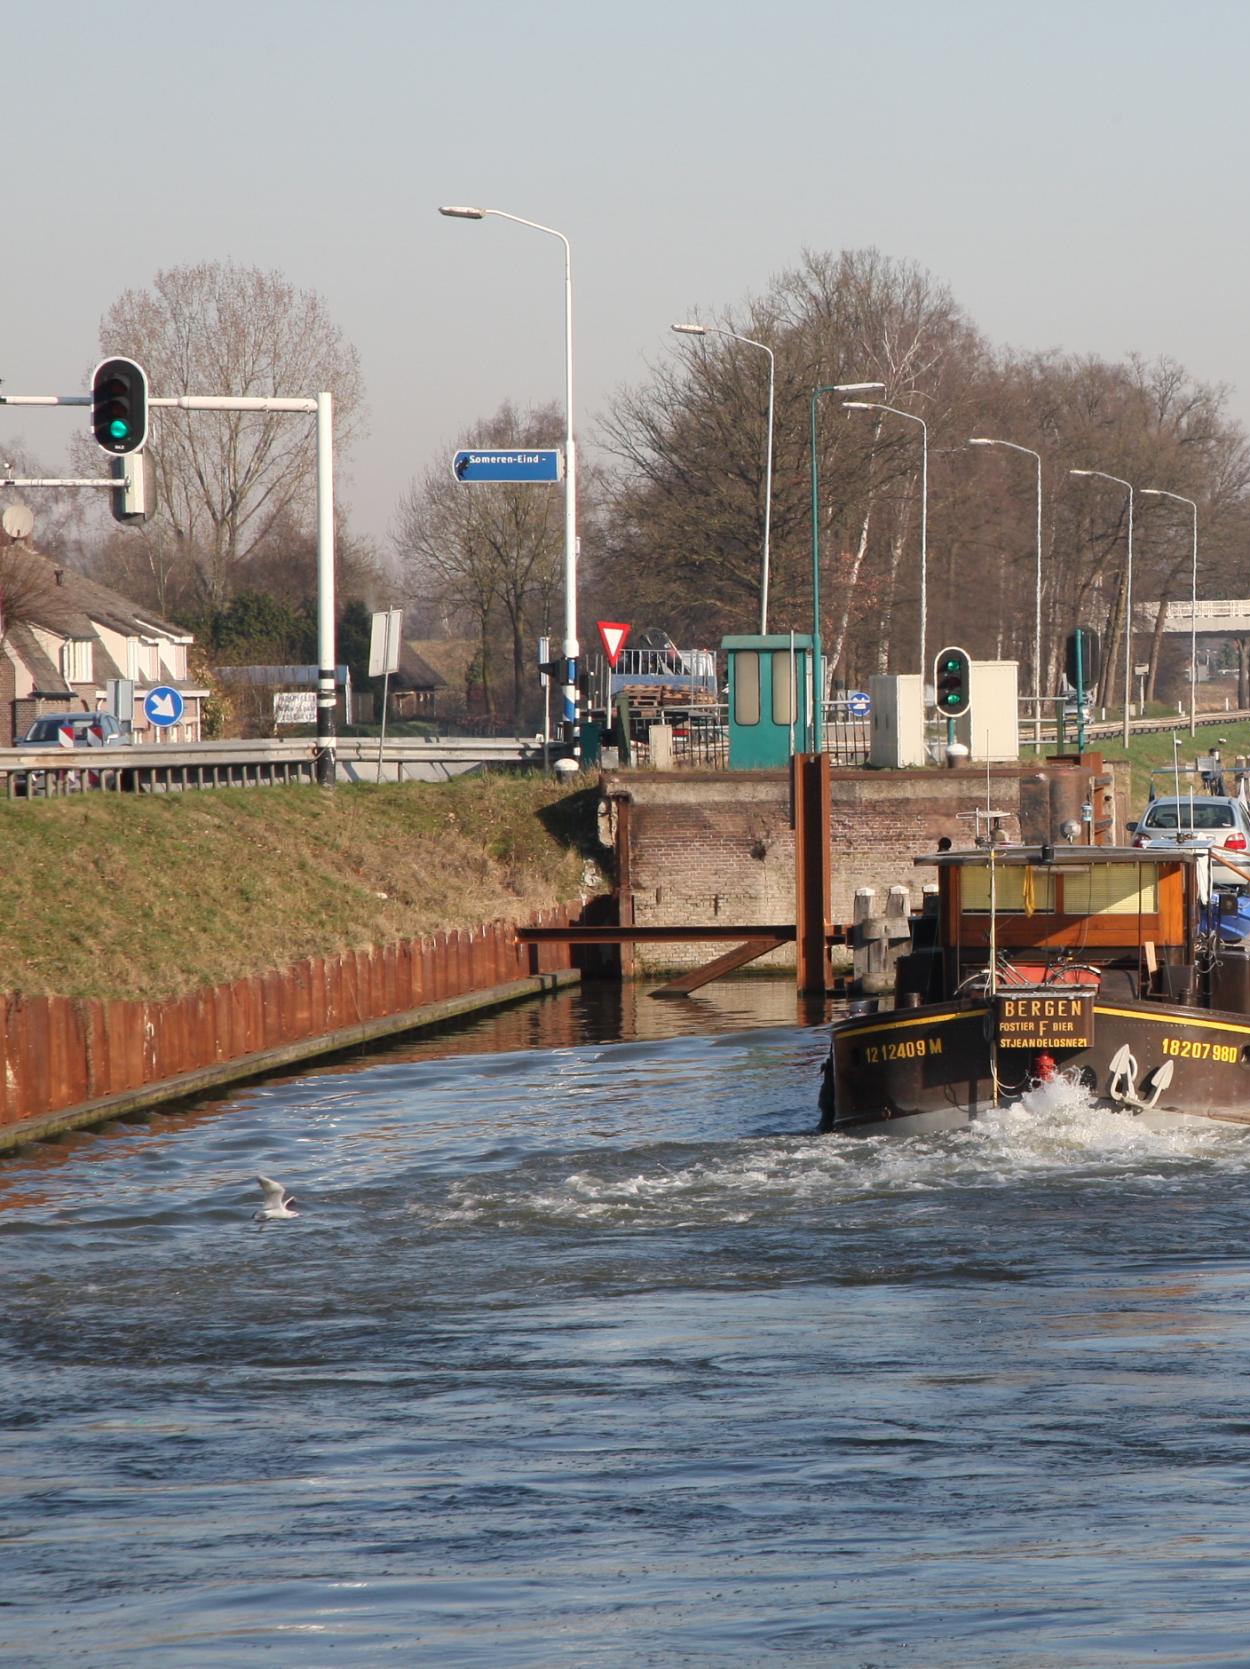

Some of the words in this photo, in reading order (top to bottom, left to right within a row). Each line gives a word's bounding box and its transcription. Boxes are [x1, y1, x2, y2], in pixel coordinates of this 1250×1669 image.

[469, 454, 539, 464] Someren-Eind
[1004, 1000, 1082, 1017] BERGEN
[999, 1021, 1035, 1032] FOSTIER
[1039, 1020, 1049, 1037] F
